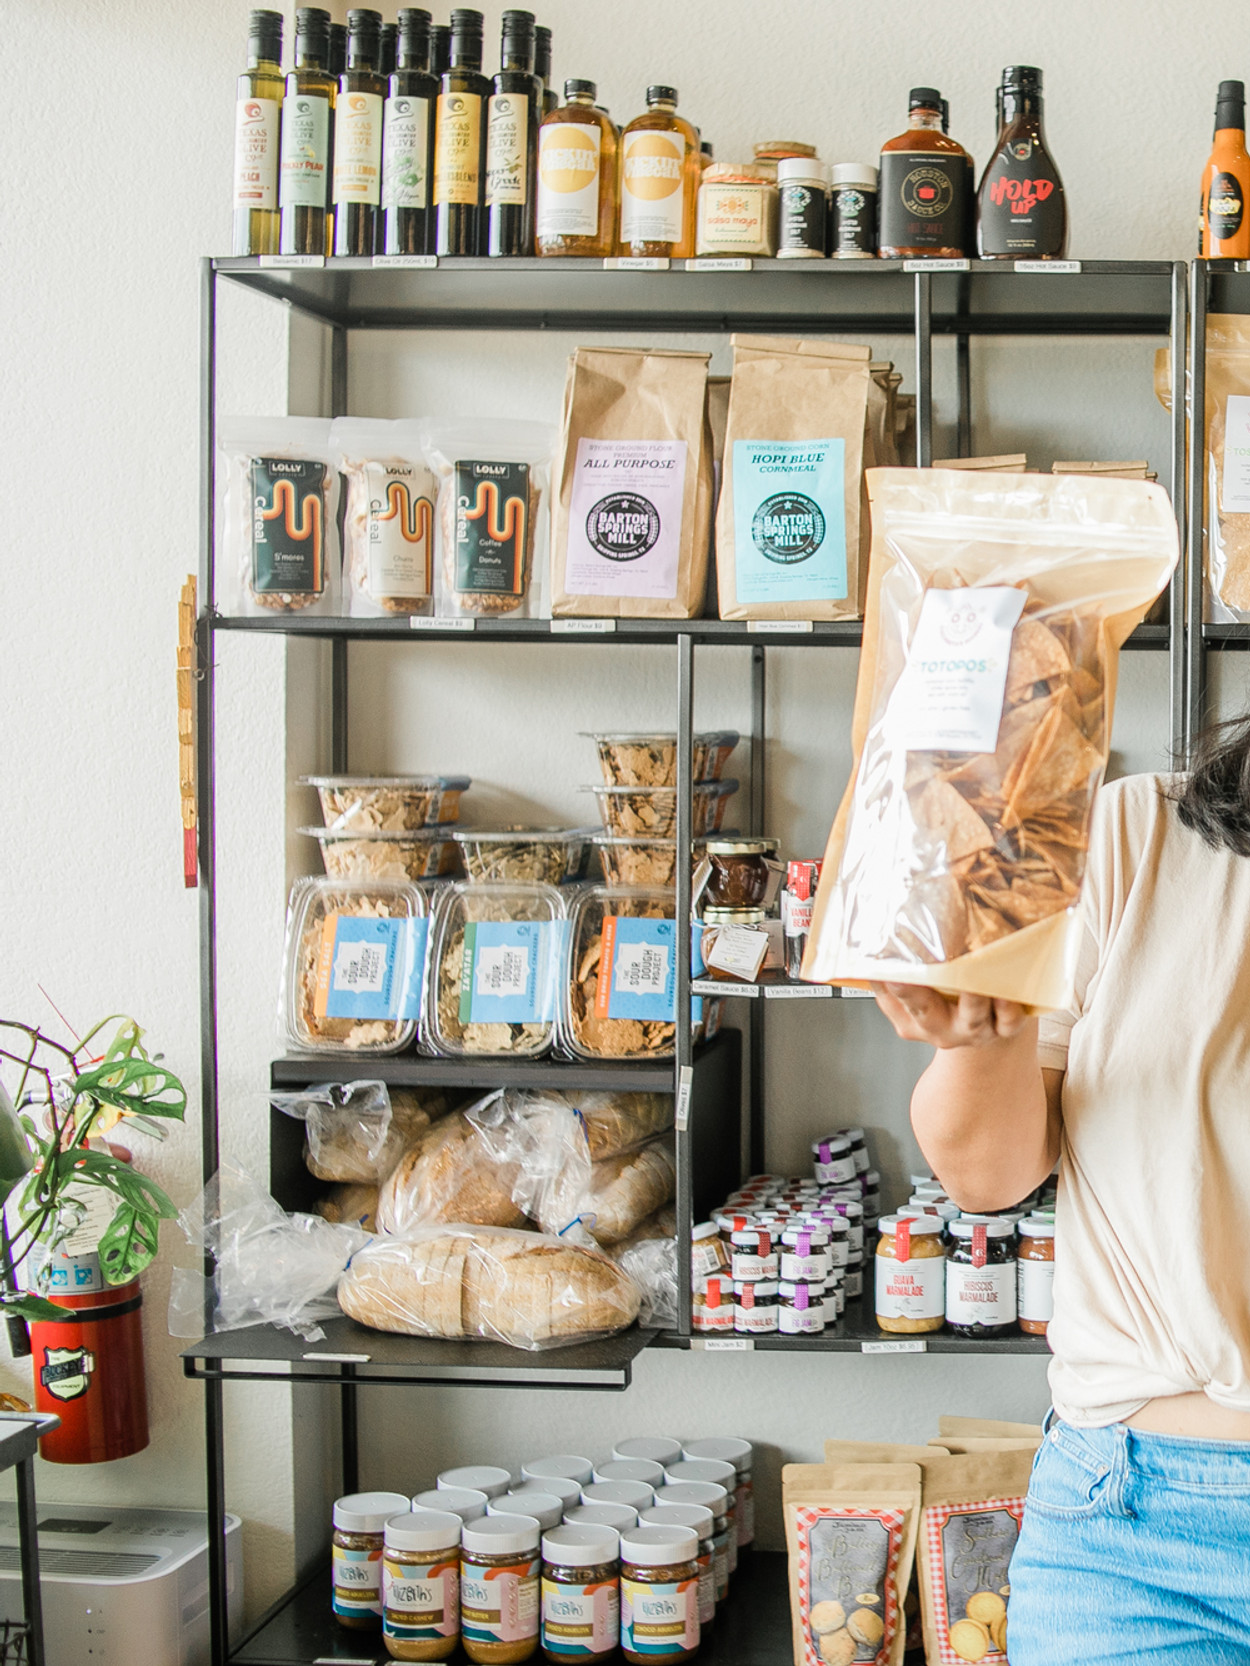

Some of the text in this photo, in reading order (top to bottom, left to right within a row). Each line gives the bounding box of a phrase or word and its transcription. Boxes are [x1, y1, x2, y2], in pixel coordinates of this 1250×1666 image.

[305, 161, 324, 171] PEAR
[910, 170, 949, 189] HOUSTON
[990, 176, 1054, 206] HOLD
[1010, 199, 1037, 215] UP
[707, 216, 757, 228] salsa maya
[584, 459, 675, 469] ALL PURPOSE
[752, 452, 825, 464] HOPI BLUE
[272, 463, 302, 473] LOLLY
[386, 467, 412, 475] LOLLY
[476, 465, 506, 474] LOLLY
[759, 464, 816, 473] CORNMEAL
[599, 512, 649, 525] BARTON
[764, 514, 813, 527] BARTON
[598, 522, 649, 535] SPRINGS
[763, 525, 814, 537] SPRINGS
[607, 533, 637, 545] MILL
[774, 535, 804, 547] MILL
[274, 552, 304, 562] S'mores
[479, 556, 501, 565] Donuts
[921, 659, 988, 673] TOTOPOS
[320, 942, 331, 989] SEA SALT
[359, 948, 371, 978] DOUGH
[369, 951, 380, 984] PROJECT
[502, 952, 514, 982] DOUGH
[641, 949, 653, 980] DOUGH
[652, 952, 662, 985] PROJECT
[348, 960, 359, 984] SOUR
[462, 949, 473, 991] ZA'ATAR
[512, 954, 522, 987] PROJECT
[629, 962, 640, 986] SOUR
[491, 965, 502, 988] SOUR
[693, 982, 740, 992] Caramel Sauce
[893, 1275, 914, 1285] GUAVA
[964, 1281, 993, 1291] HIBISCUS
[886, 1285, 924, 1297] MARMALADE
[959, 1291, 998, 1303] MARMALADE
